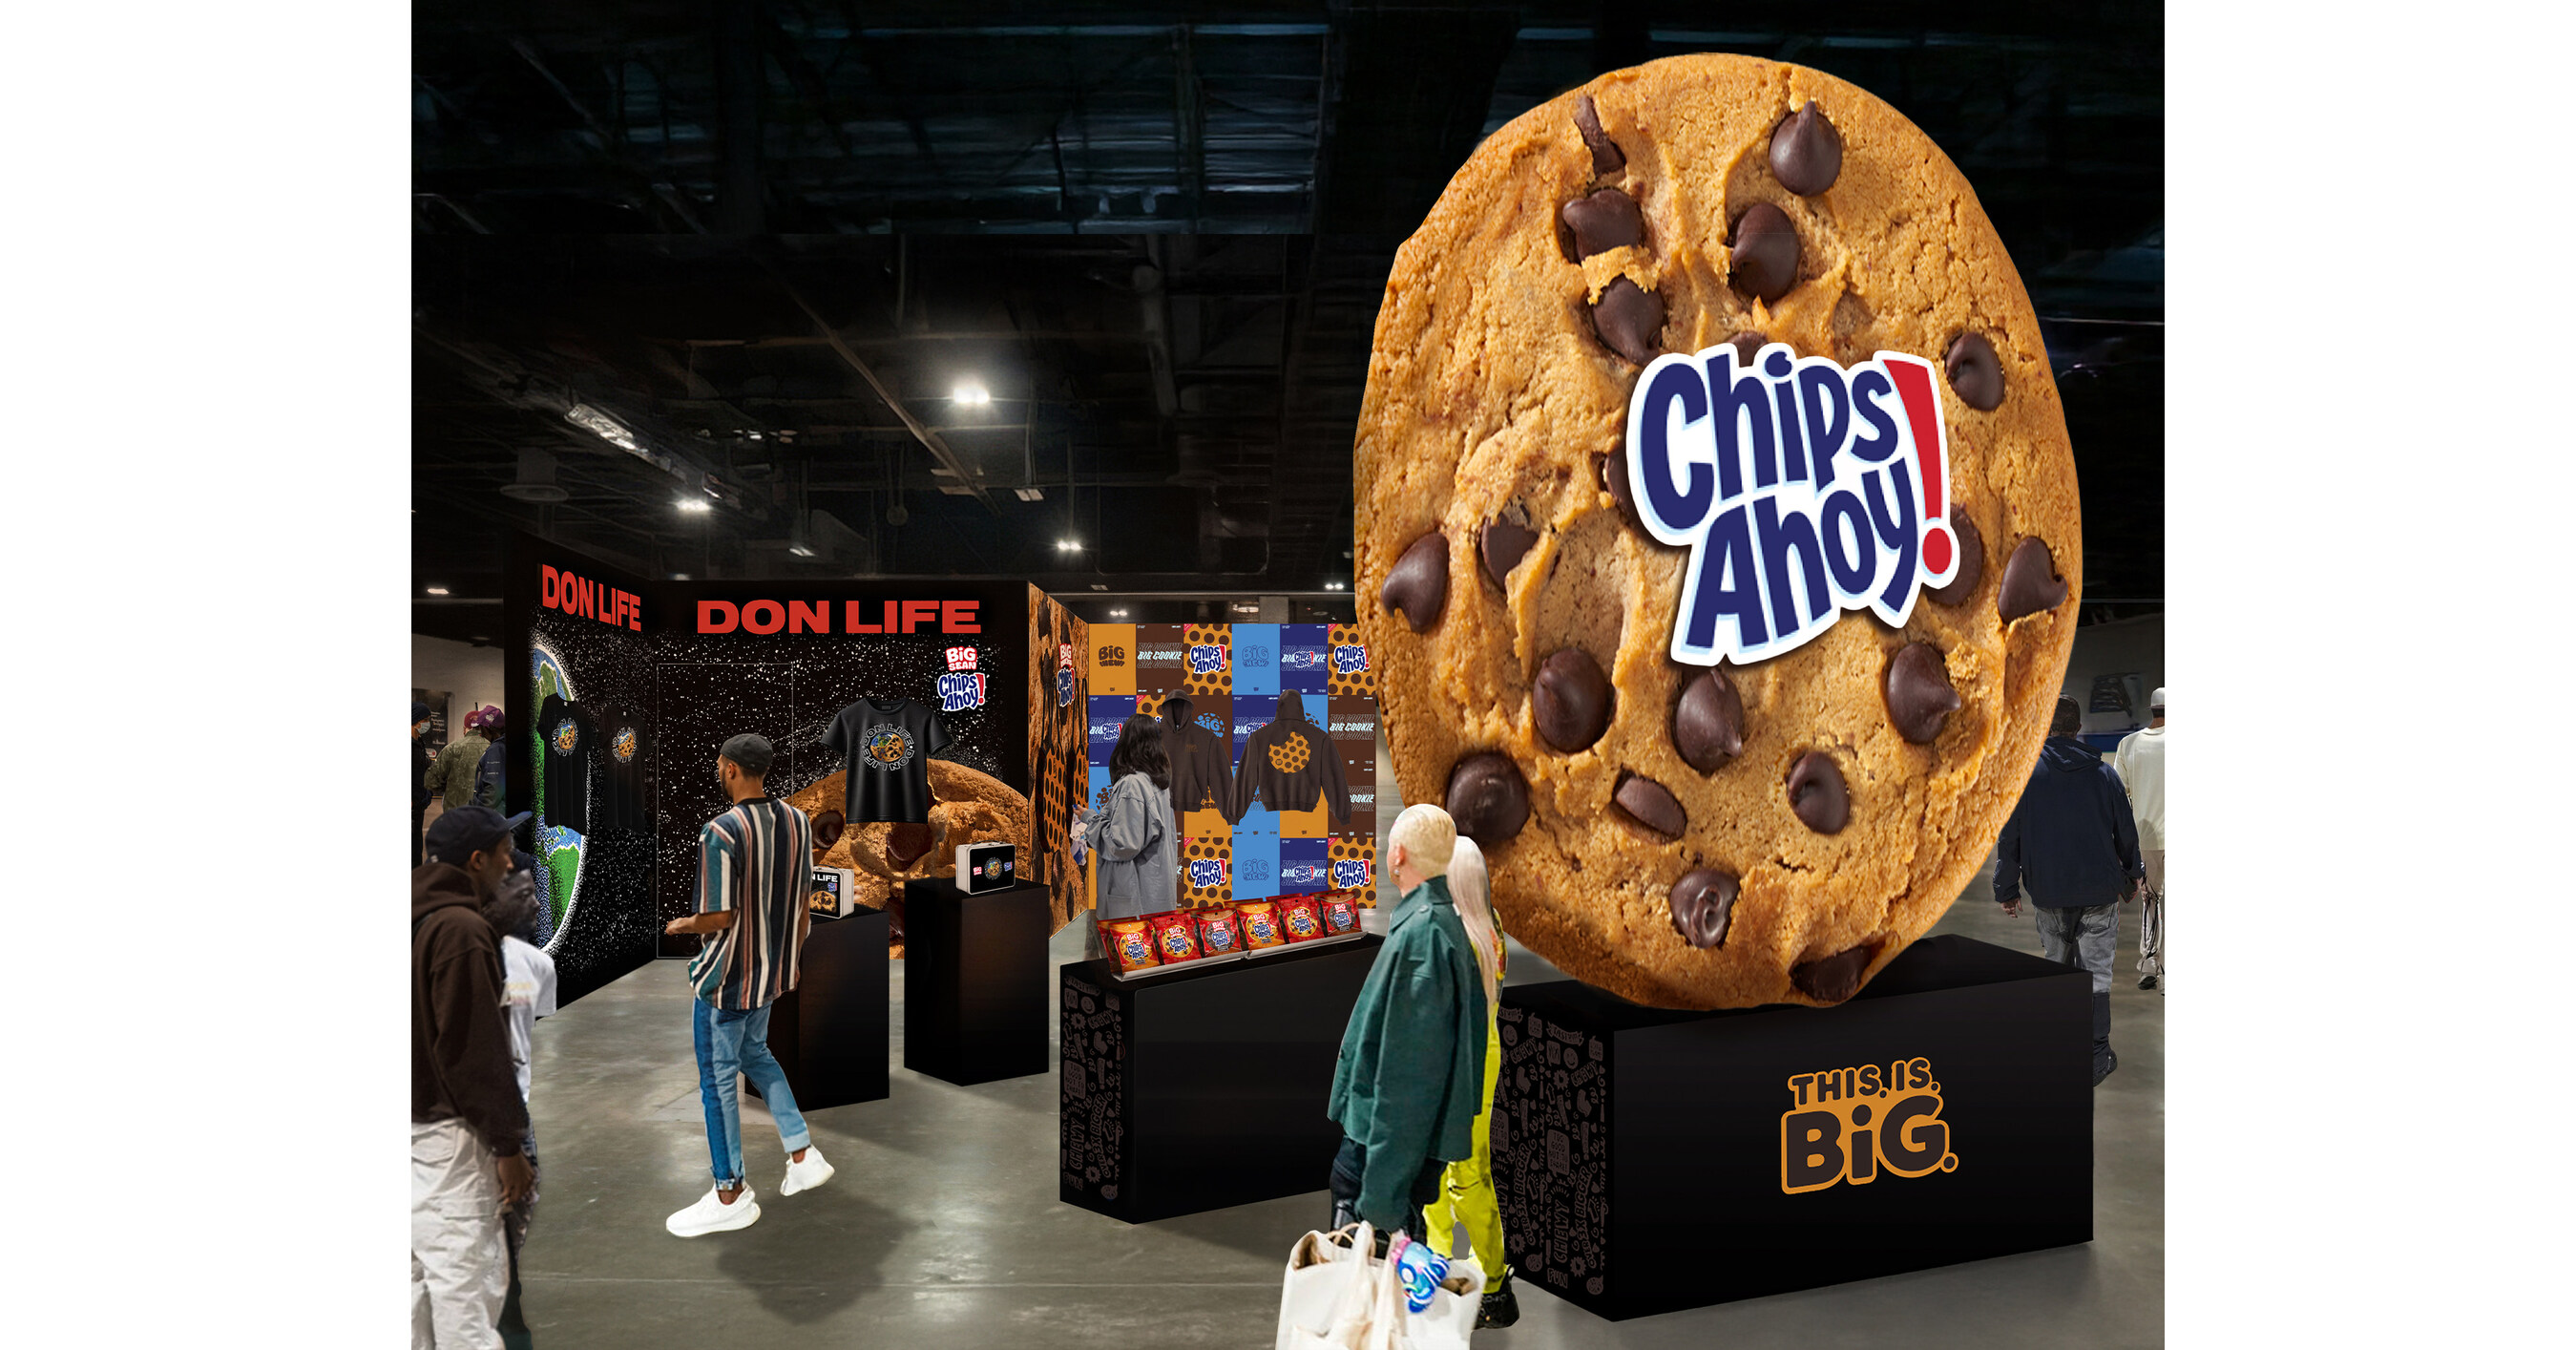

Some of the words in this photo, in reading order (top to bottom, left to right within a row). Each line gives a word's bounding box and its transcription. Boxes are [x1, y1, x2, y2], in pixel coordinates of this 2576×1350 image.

[1639, 349, 1900, 531] Chips
[1685, 358, 1953, 650] Ahoy!
[541, 563, 594, 620] DON
[598, 582, 641, 632] LIFE
[697, 599, 830, 635] DON
[846, 600, 981, 634] LIFE
[948, 661, 976, 671] SEAN
[1137, 650, 1153, 661] BIG
[1190, 644, 1220, 663] Chips
[1195, 644, 1225, 673] Ahoy!
[1335, 644, 1364, 663] Chips
[938, 672, 977, 697] Chips
[943, 672, 984, 710] Ahoy!
[860, 723, 886, 745] DON
[887, 723, 914, 747] LIFE
[1329, 723, 1345, 731] BIG
[1350, 793, 1374, 803] OOKIE
[817, 874, 838, 883] LIFE
[1190, 858, 1220, 877] Chips
[1195, 858, 1225, 888] Ahoy!
[1334, 859, 1364, 877] Chips
[1339, 859, 1370, 888] Ahoy!
[1790, 1065, 1888, 1106] THIS.
[1894, 1057, 1940, 1092] IS.
[1089, 1092, 1108, 1136] BIGGER
[1068, 1116, 1085, 1171] CHEWY
[1513, 1142, 1532, 1195] BIGGER
[1574, 1165, 1593, 1218] BIGGER
[1553, 1198, 1570, 1264] CHEWY
[1546, 1267, 1568, 1290] FUN
